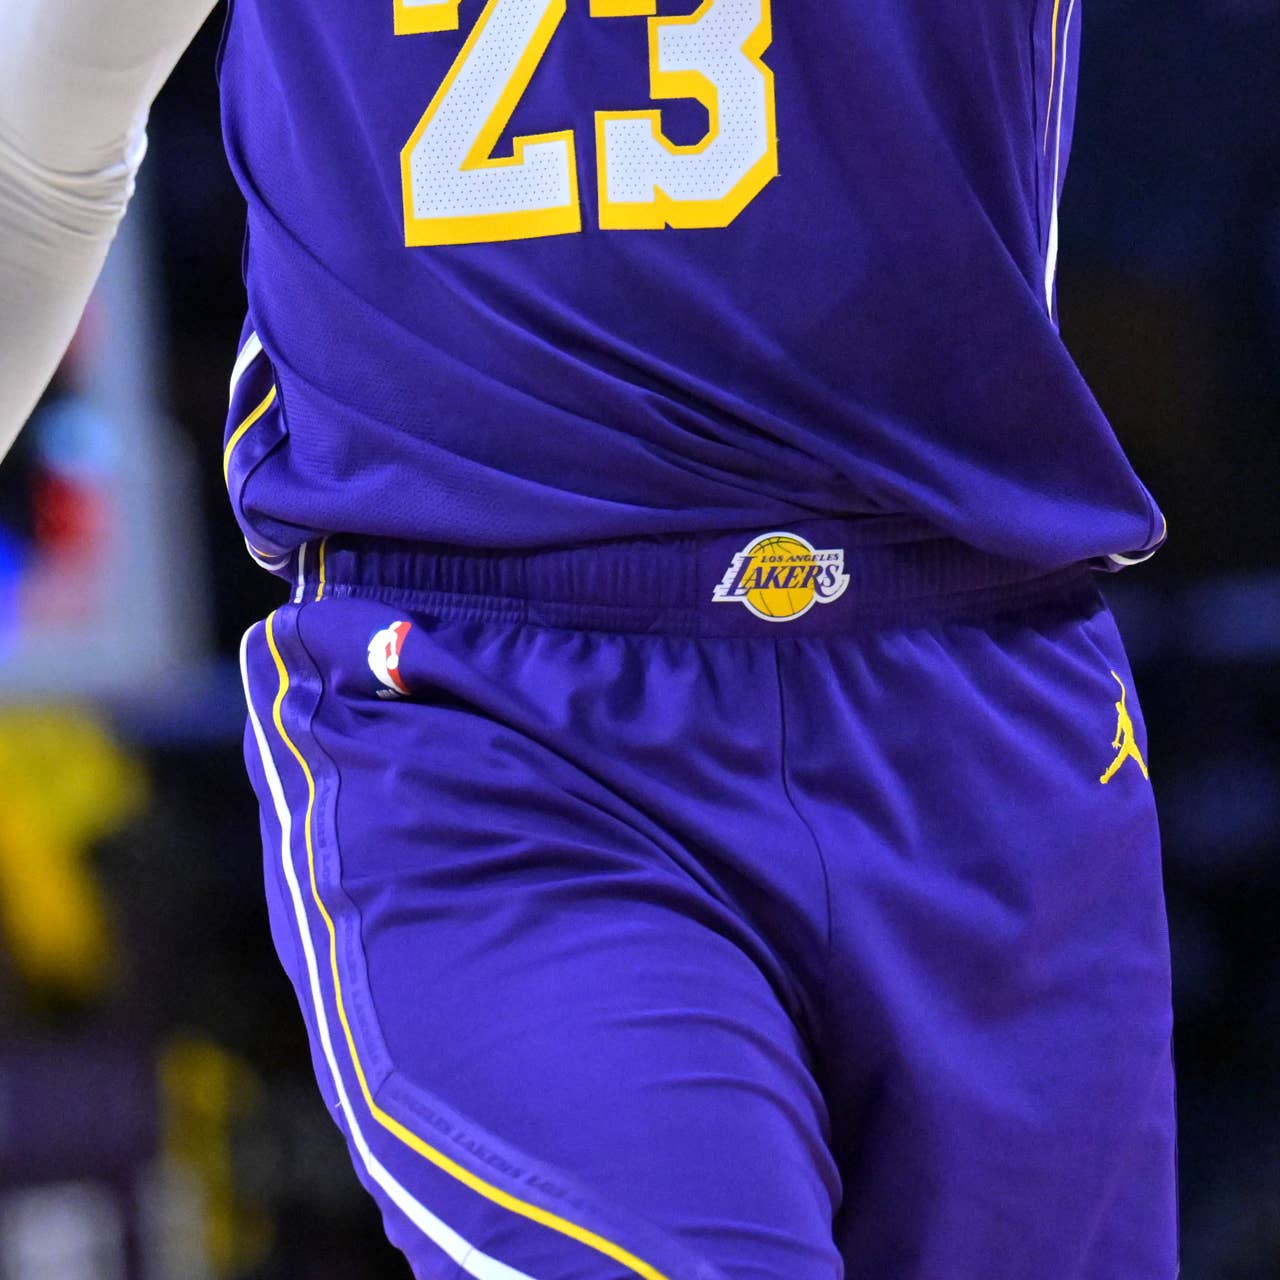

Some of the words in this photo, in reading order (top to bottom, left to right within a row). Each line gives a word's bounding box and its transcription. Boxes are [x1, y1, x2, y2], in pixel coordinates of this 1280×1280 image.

[761, 554, 784, 563] LOS
[786, 552, 840, 563] ANGELES
[719, 555, 845, 598] LAKERS
